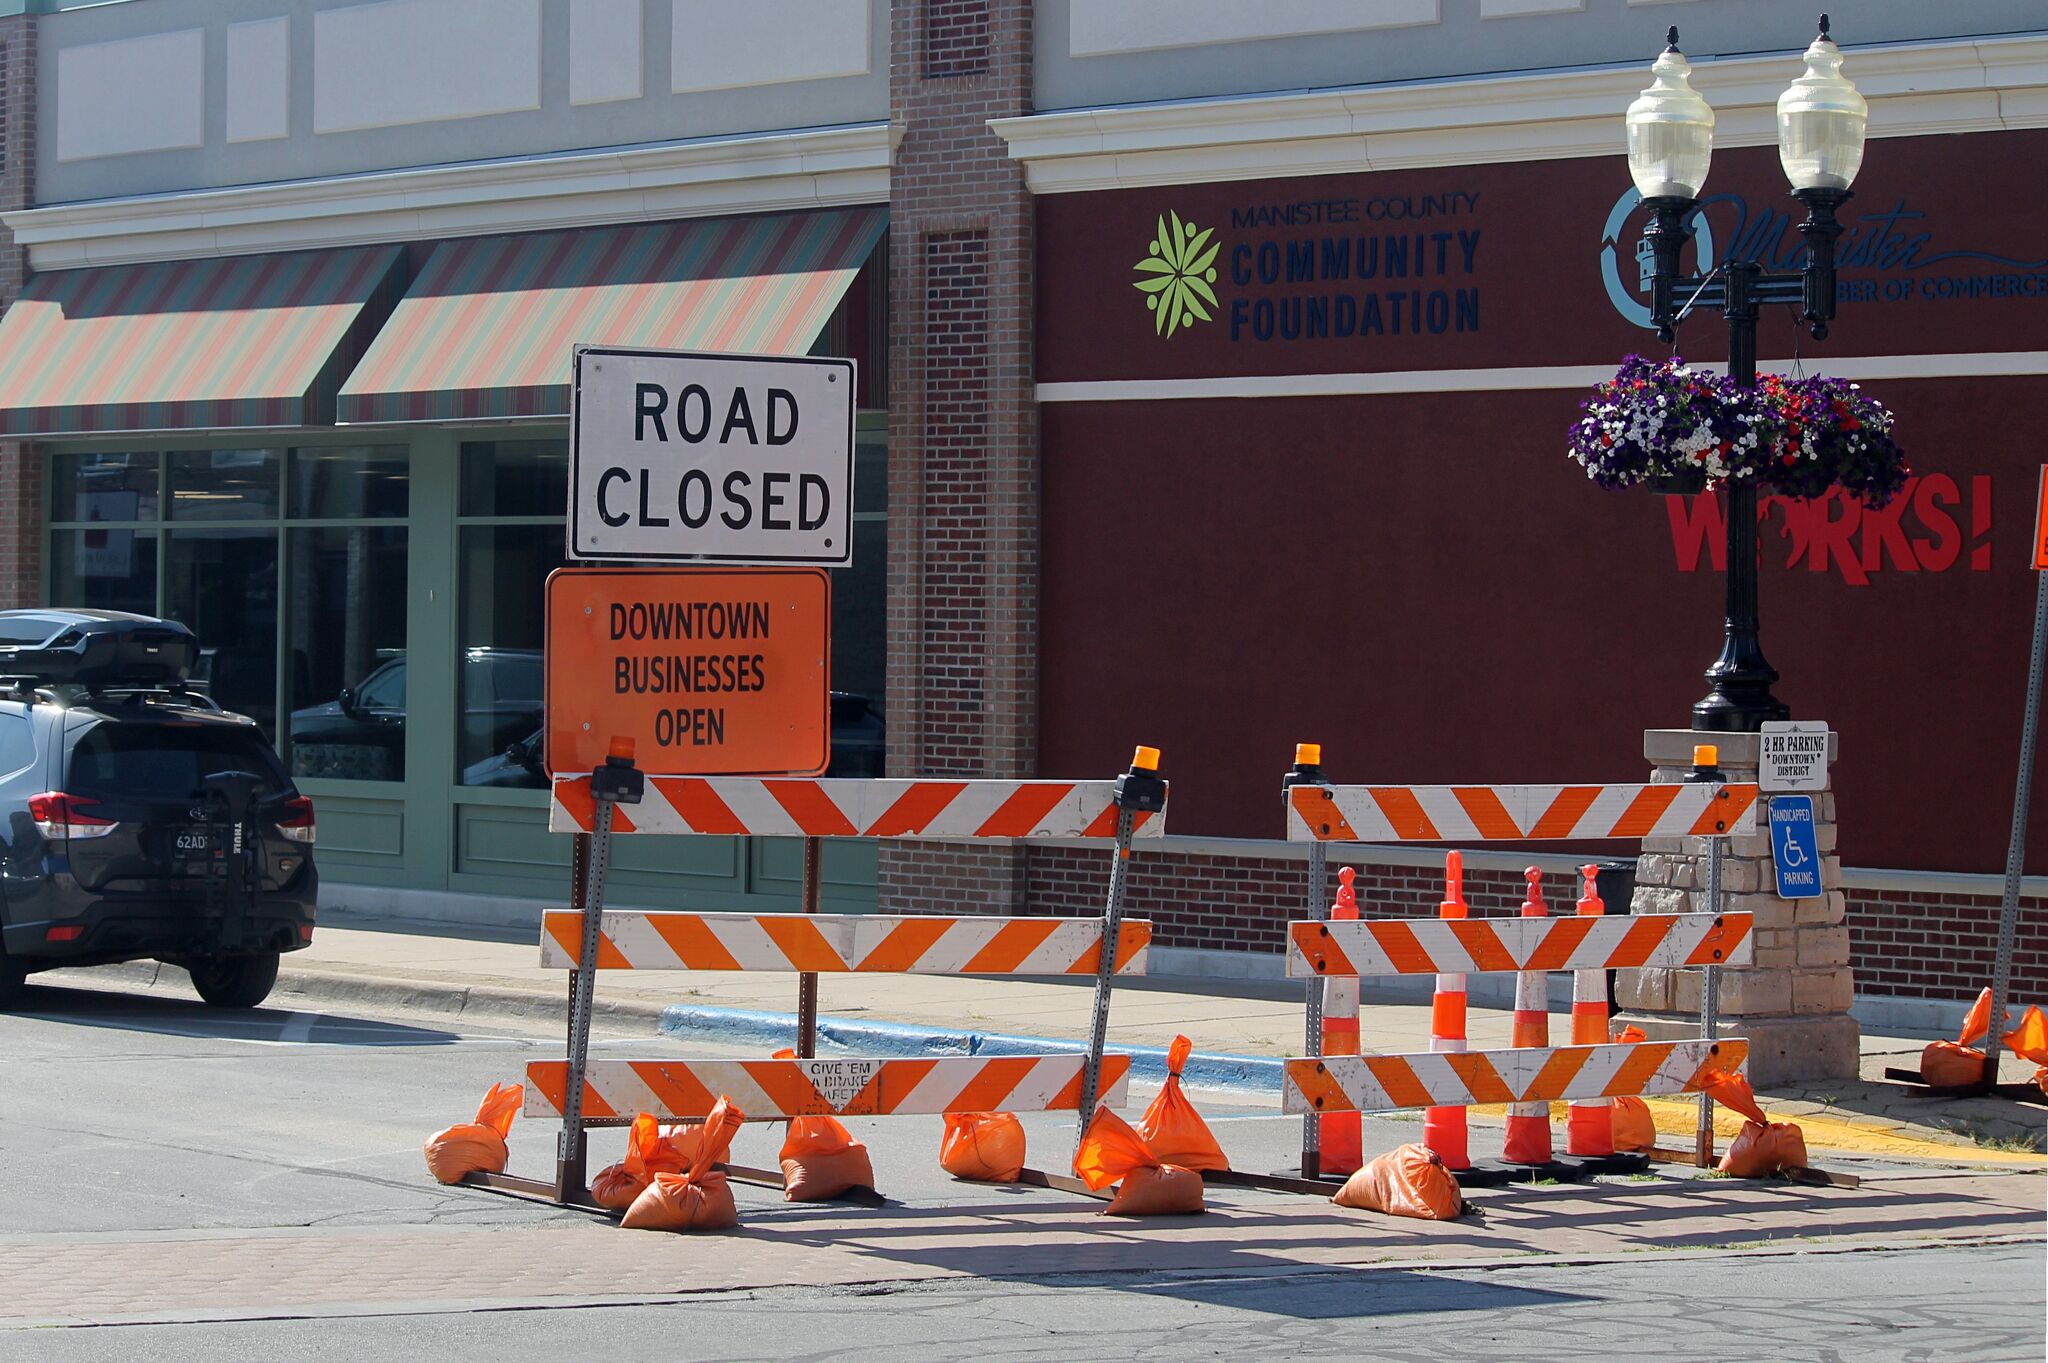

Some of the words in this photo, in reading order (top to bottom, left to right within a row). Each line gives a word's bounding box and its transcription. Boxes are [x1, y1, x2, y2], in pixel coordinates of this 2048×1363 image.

[1231, 199, 1360, 229] MANISTEE
[1366, 191, 1480, 222] COUNTY
[1231, 229, 1481, 286] COMMUNITY
[1883, 278, 1914, 302] OF
[1919, 274, 2048, 300] COMMERCE
[1230, 288, 1480, 341] FOUNDATION
[635, 382, 799, 446] ROAD
[597, 466, 831, 531] CLOSED
[610, 602, 769, 641] DOWNTOWN
[615, 654, 765, 694] BUSINESSES
[655, 708, 725, 746] OPEN
[1764, 736, 1770, 752] 2
[1772, 736, 1785, 752] HR
[1787, 736, 1824, 752] PARKING
[1772, 753, 1816, 764] DOWNTOWN
[1777, 765, 1810, 776] DISTRICT
[1772, 808, 1811, 822] HANDICAPPED
[233, 822, 242, 854] THULE
[1783, 871, 1814, 885] PARKING
[811, 1063, 842, 1074] GIVE
[847, 1063, 870, 1074] 'EM
[811, 1077, 820, 1087] A
[824, 1075, 869, 1087] BRAKE
[813, 1089, 864, 1101] SAFETY
